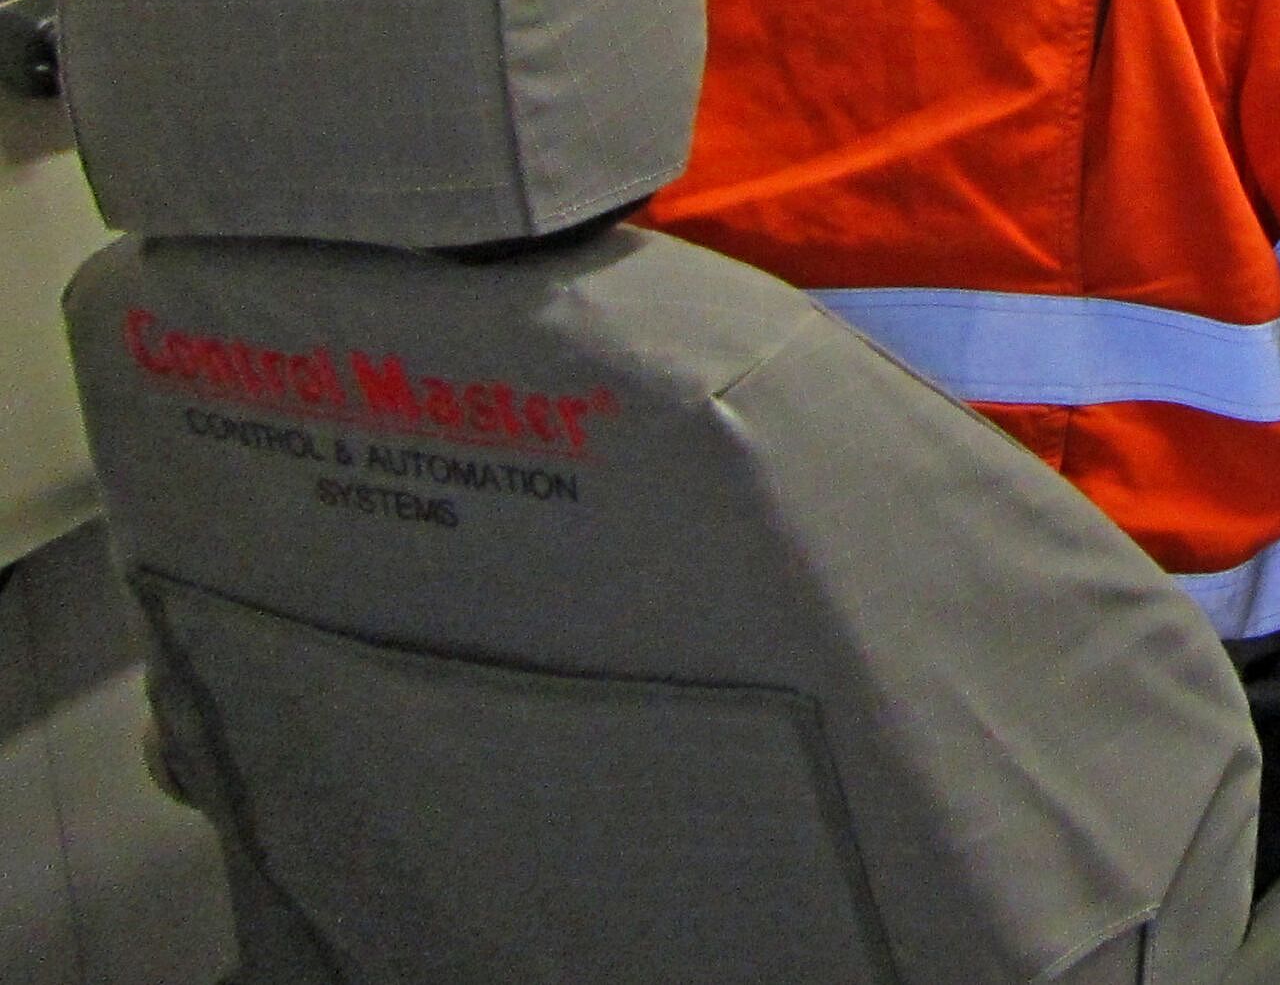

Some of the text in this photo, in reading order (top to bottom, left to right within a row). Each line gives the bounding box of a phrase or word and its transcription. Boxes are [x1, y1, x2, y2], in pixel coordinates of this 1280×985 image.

[123, 306, 347, 406] Control
[185, 406, 580, 504] CONTROL & AUTOMATION
[315, 477, 460, 529] SYSTEMS
